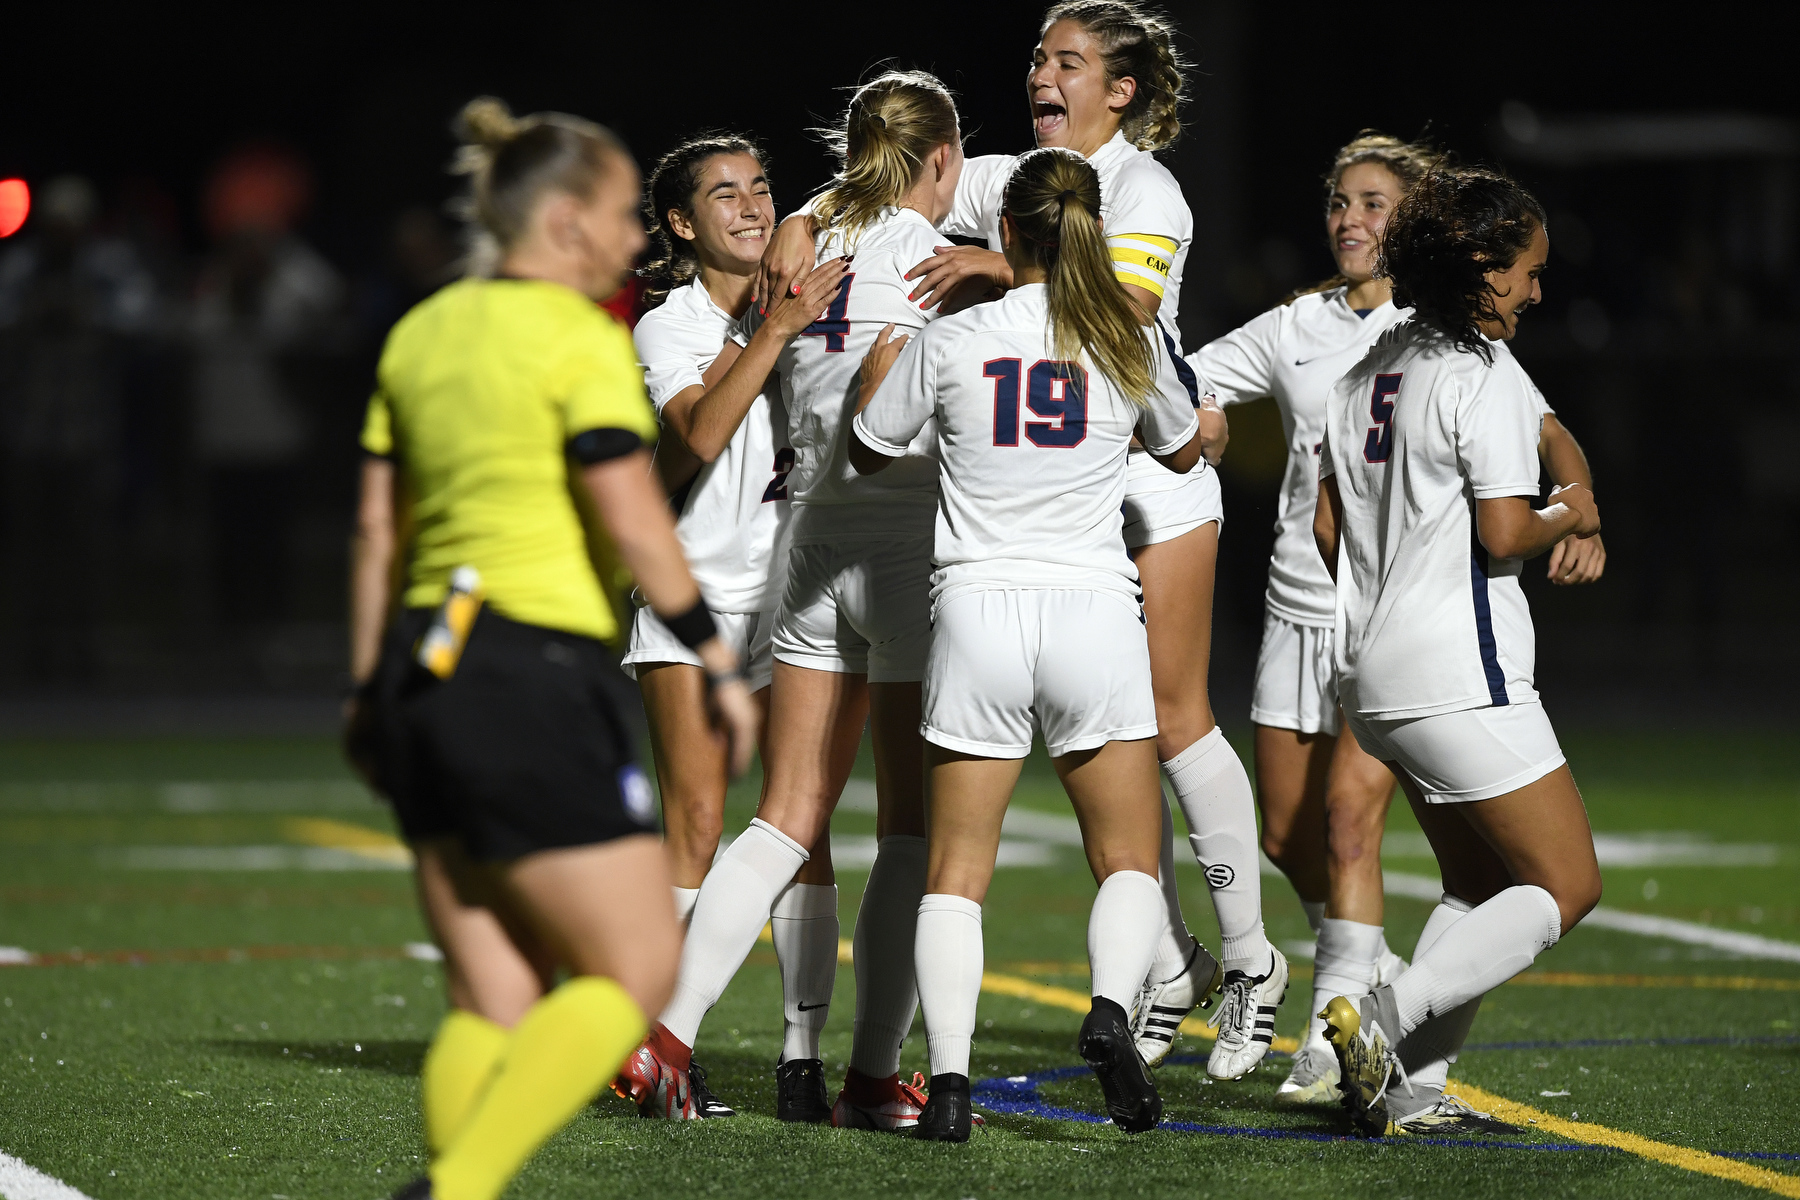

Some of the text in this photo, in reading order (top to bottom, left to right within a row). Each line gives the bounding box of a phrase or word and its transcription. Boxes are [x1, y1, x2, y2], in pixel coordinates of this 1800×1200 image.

[801, 272, 856, 352] 4
[983, 357, 1088, 448] 19
[1363, 372, 1403, 463] 5
[761, 447, 795, 504] 2
